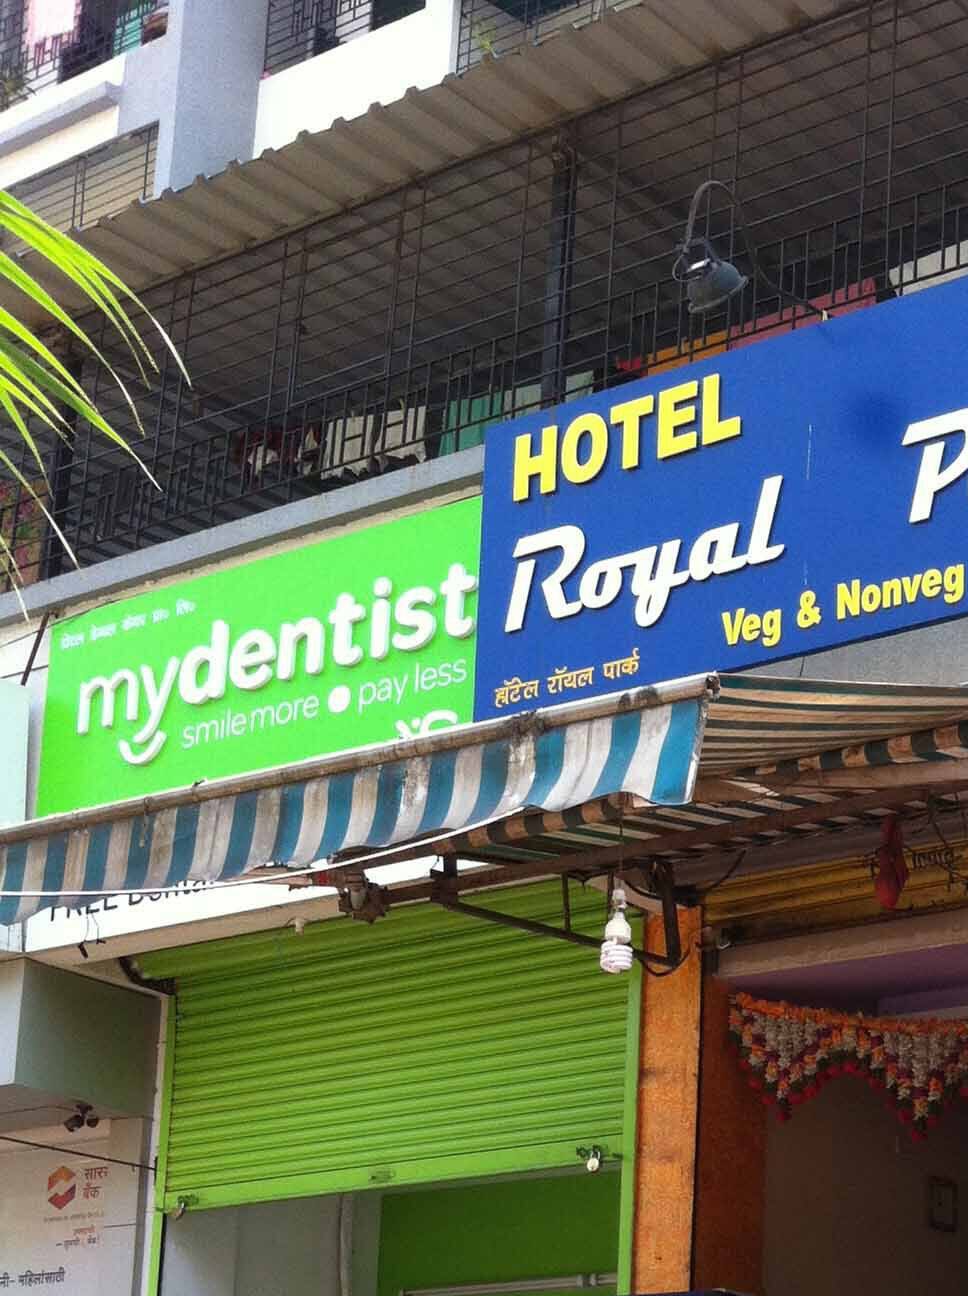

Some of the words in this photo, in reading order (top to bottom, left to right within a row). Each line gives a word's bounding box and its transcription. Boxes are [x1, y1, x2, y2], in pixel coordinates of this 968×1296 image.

[512, 373, 742, 503] HOTEL
[504, 474, 786, 633] Royal
[722, 606, 782, 648] Veg
[796, 589, 822, 630] &
[836, 561, 965, 621] Nonveg
[358, 674, 408, 712] pay
[414, 658, 468, 690] less
[547, 665, 594, 695] रॉयल
[602, 647, 641, 681] पार्क
